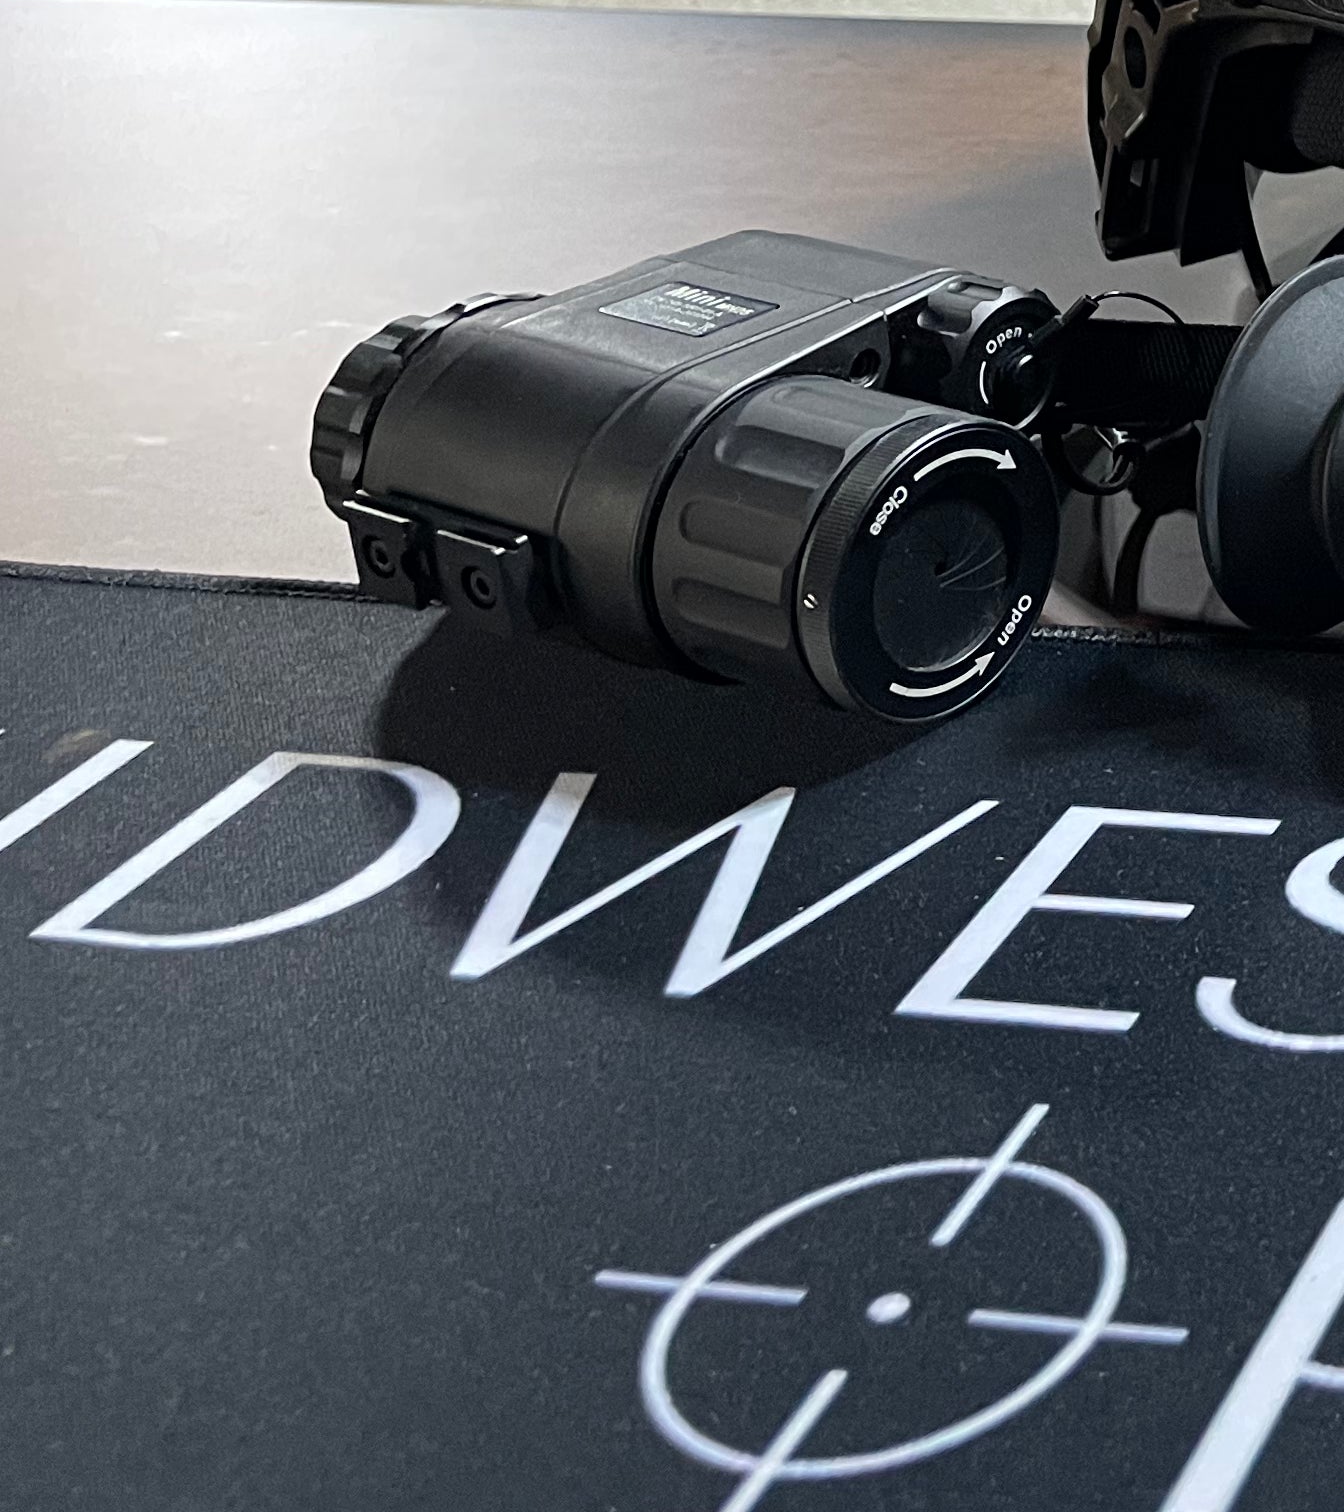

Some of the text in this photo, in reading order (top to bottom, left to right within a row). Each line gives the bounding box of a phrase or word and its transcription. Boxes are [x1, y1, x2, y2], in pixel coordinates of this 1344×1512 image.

[664, 286, 731, 306] Mini
[985, 327, 1022, 355] Open
[869, 486, 908, 536] Close
[997, 594, 1032, 646] Open
